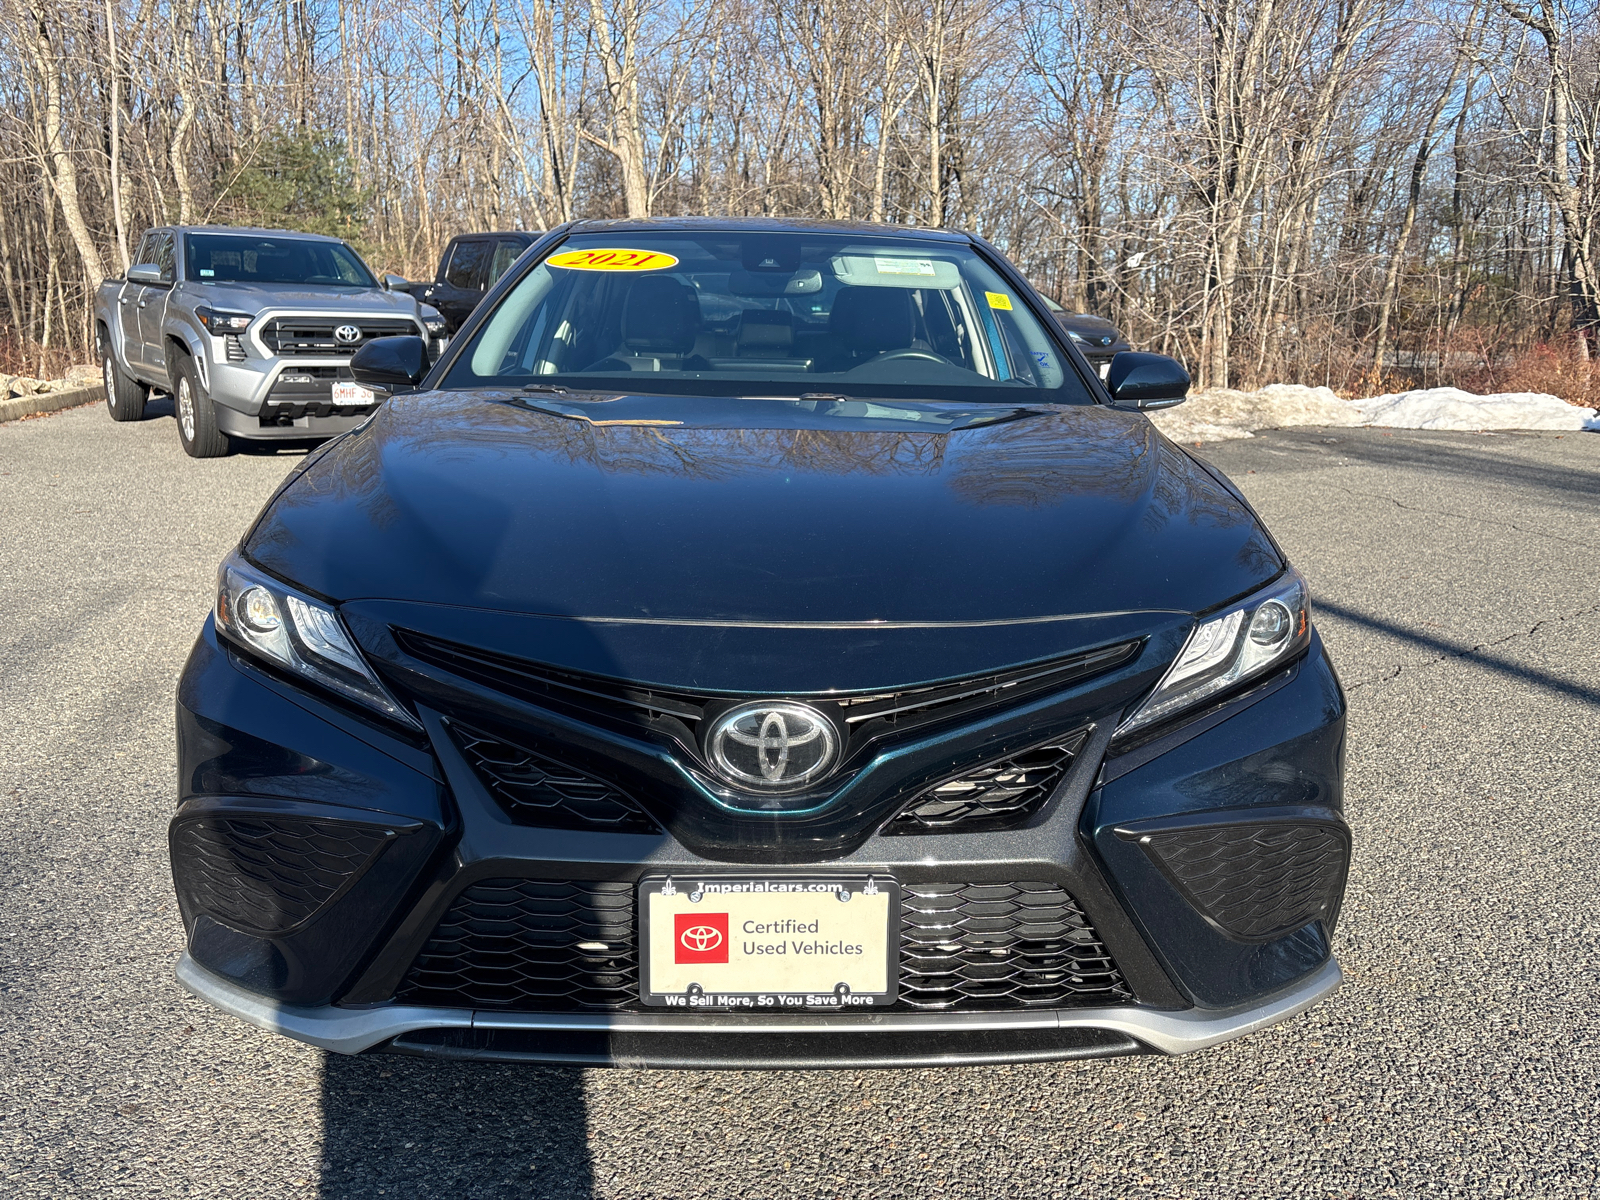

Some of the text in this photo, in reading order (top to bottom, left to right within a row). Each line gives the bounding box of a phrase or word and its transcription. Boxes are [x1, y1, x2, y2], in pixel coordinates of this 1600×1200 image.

[564, 252, 658, 267] 2021
[334, 388, 356, 399] 6MHF
[697, 881, 843, 895] Imperialcars.com
[742, 919, 819, 934] Certified
[743, 940, 863, 955] Used Vehicles
[665, 995, 874, 1007] We Sell More, So You Save More
